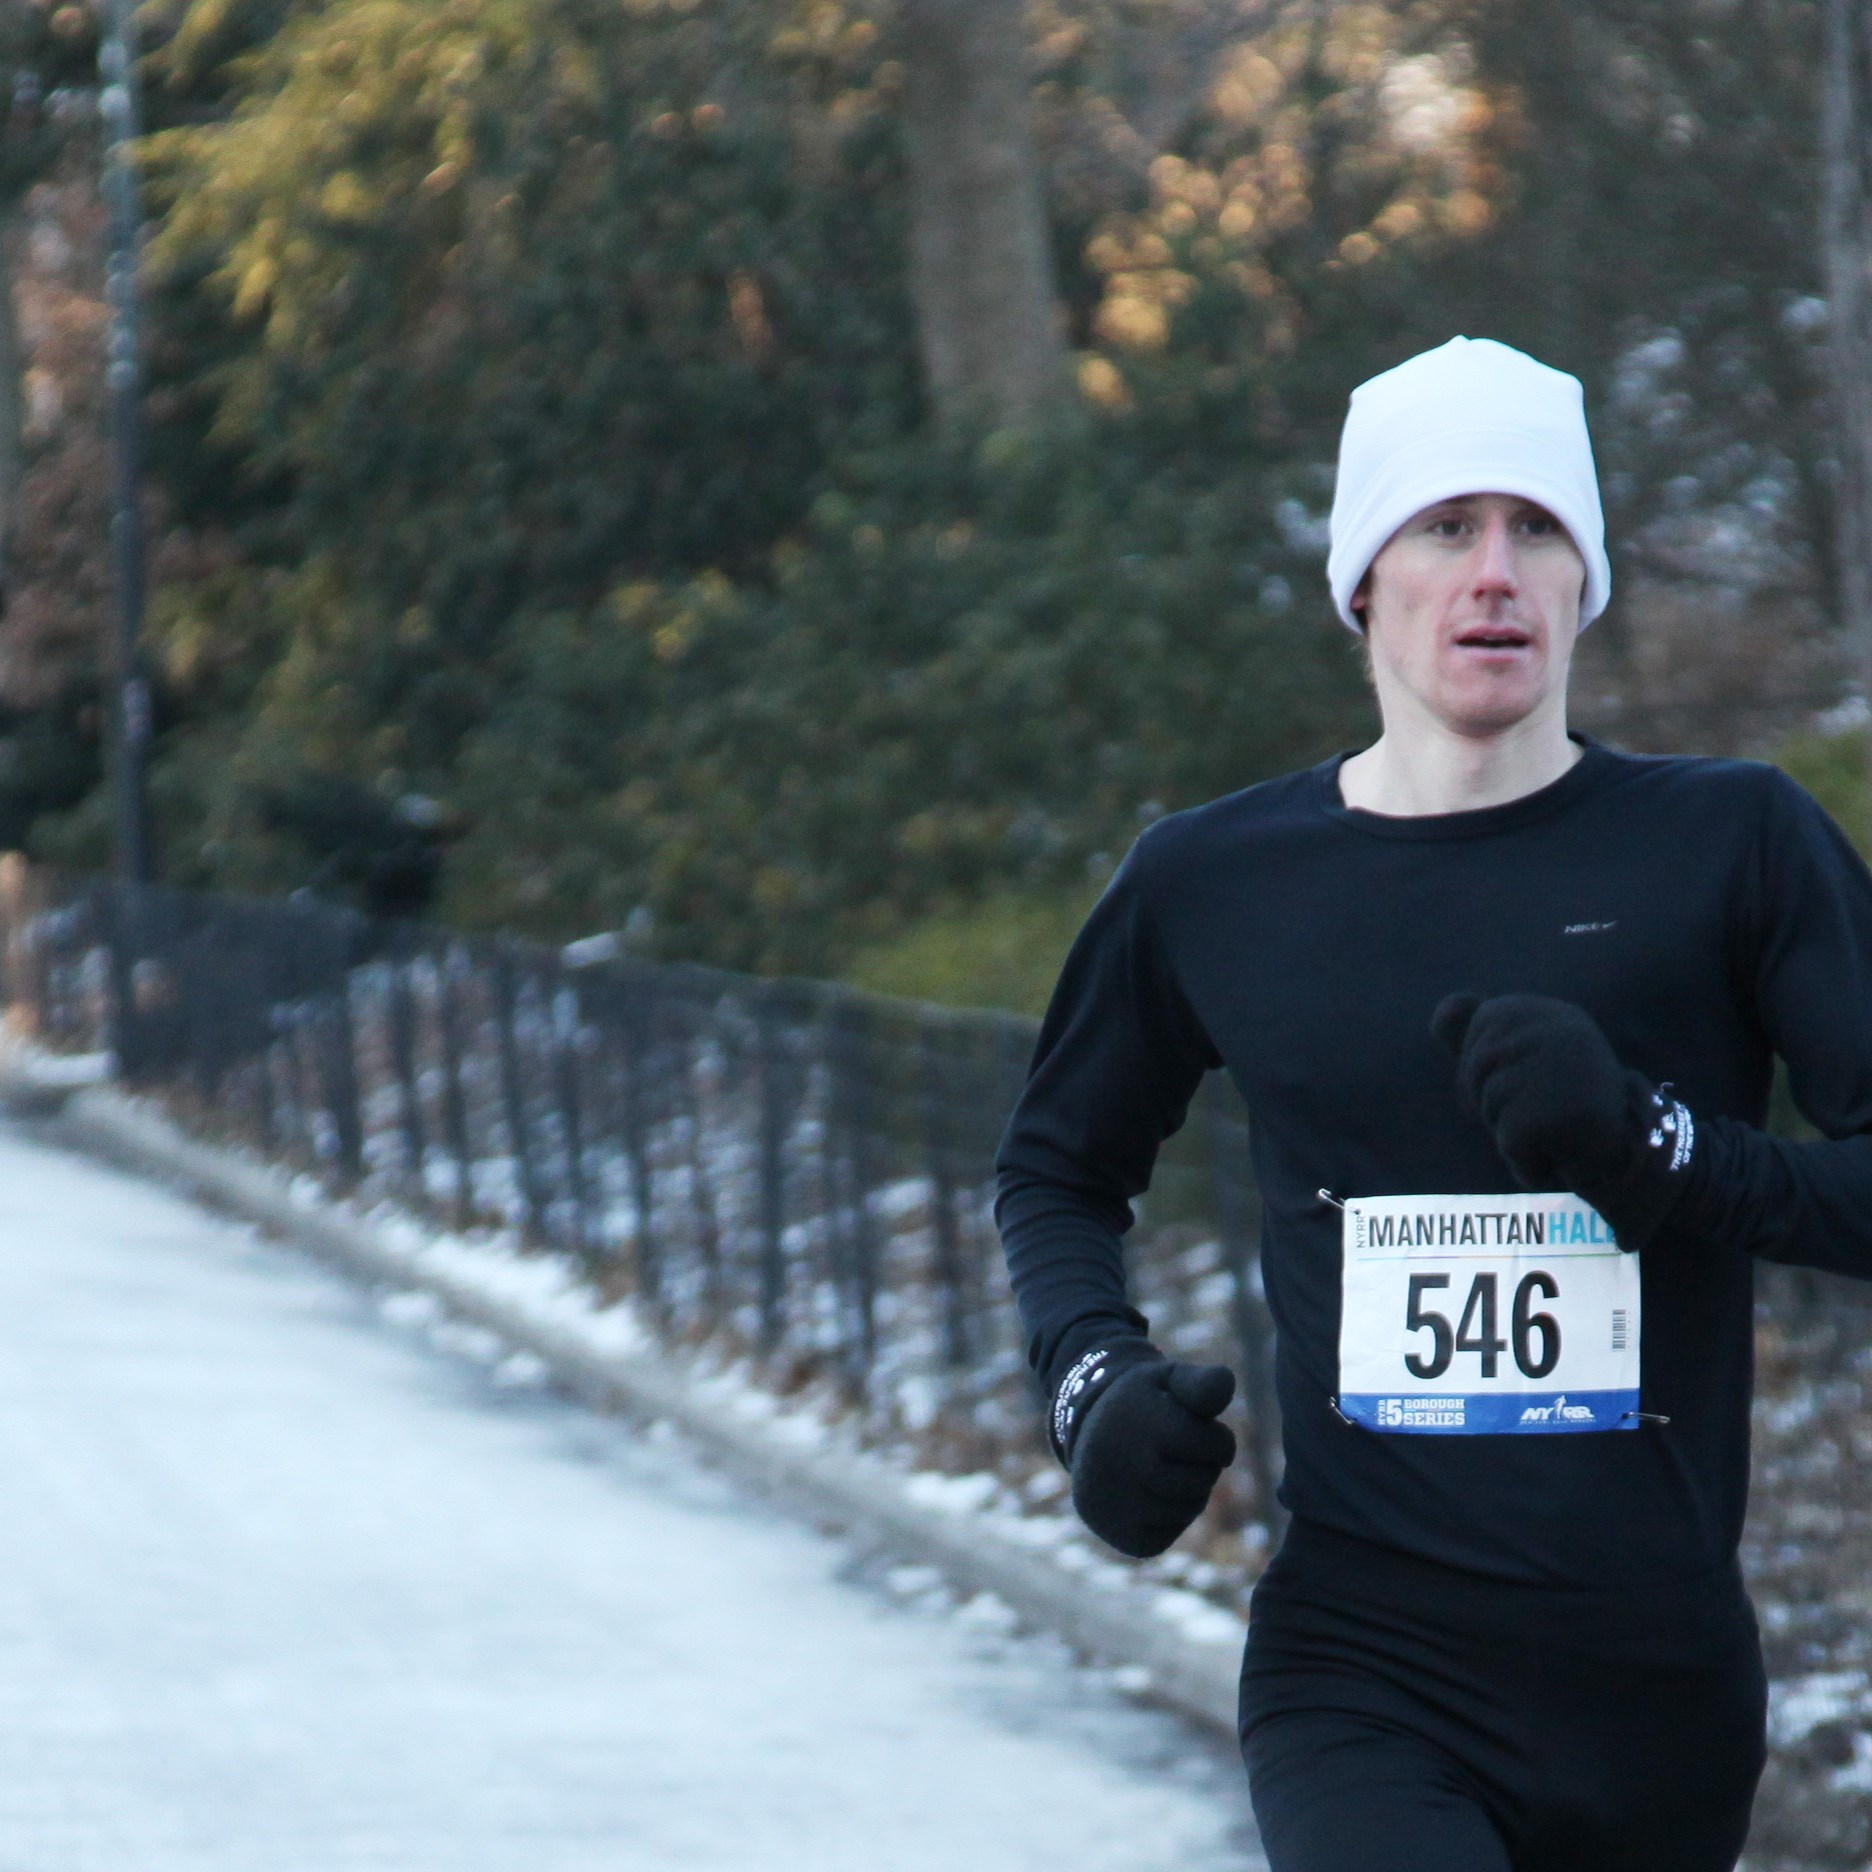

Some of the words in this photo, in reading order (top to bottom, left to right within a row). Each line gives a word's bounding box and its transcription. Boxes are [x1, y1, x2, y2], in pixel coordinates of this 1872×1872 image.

[1356, 1216, 1366, 1249] NYRR
[1404, 1270, 1562, 1380] 546
[1386, 1399, 1402, 1425] 5
[1403, 1398, 1465, 1409] BOROUGH
[1403, 1412, 1465, 1425] SERIES
